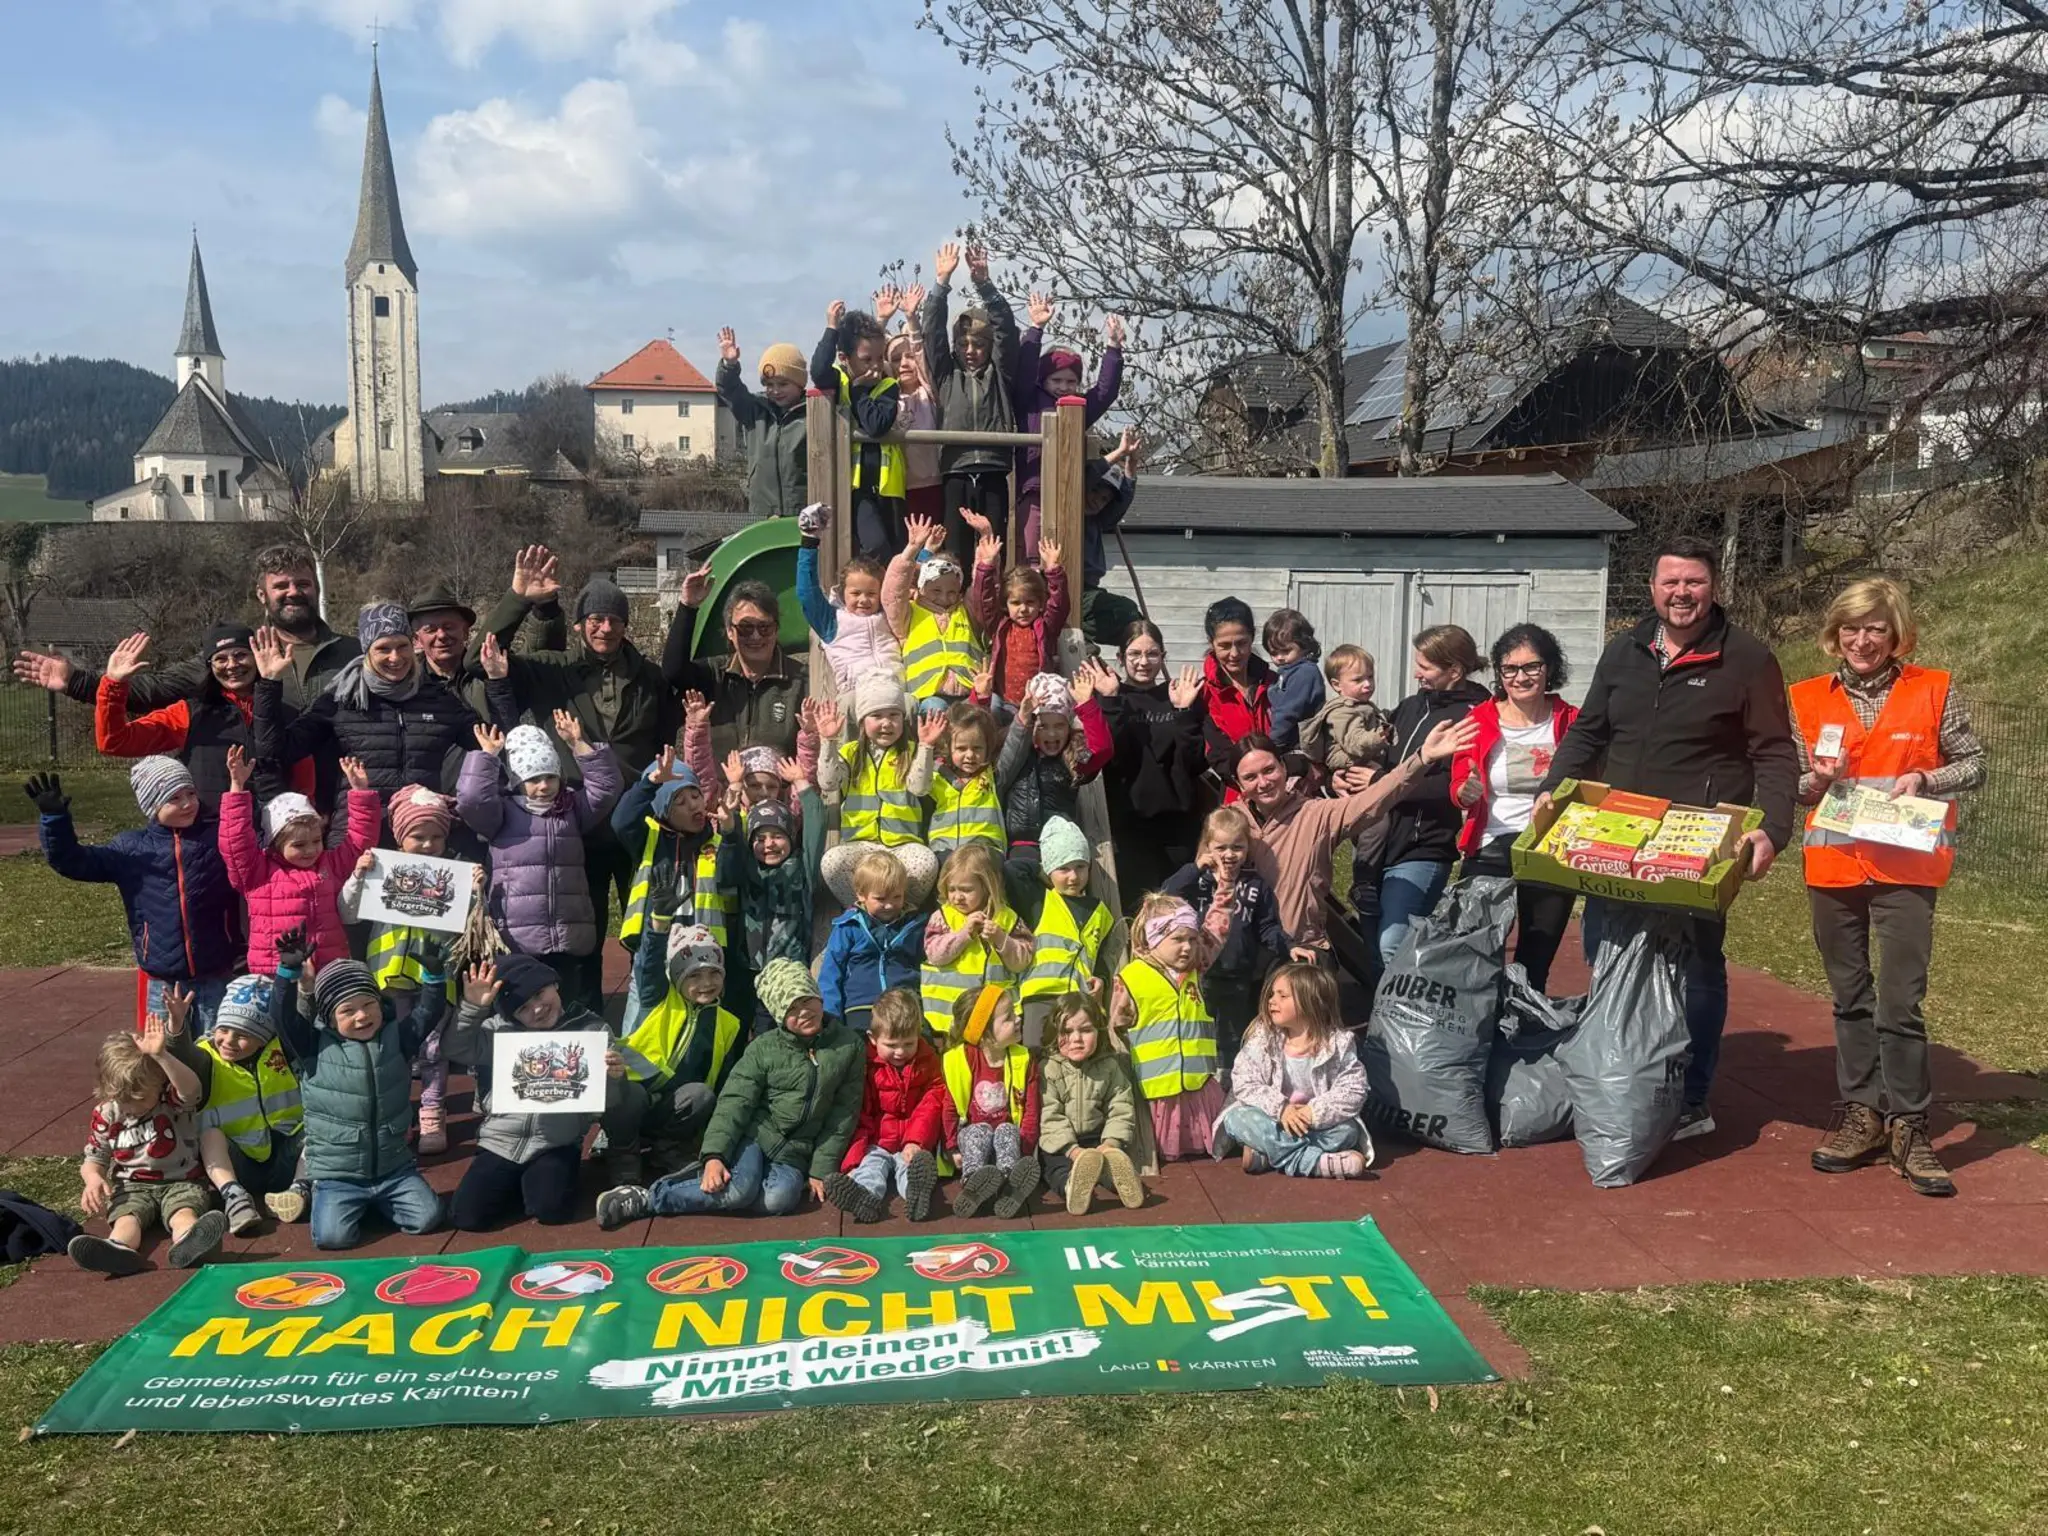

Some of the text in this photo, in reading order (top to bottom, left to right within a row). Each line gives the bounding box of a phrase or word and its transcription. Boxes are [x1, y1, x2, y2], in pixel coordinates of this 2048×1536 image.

[1570, 854, 1629, 874] Cornetto
[1578, 875, 1646, 901] Kolios
[391, 900, 439, 916] Sörgerberg
[523, 1086, 575, 1098] Sörgerberg
[1131, 1247, 1343, 1260] Landwirtschaftskammer
[1134, 1257, 1210, 1268] Kärnten
[652, 1285, 1035, 1349] NICHT
[1072, 1274, 1389, 1342] MIST!
[644, 1331, 959, 1381] Nimm deinen
[1099, 1357, 1277, 1373] LAND KÄRNTEN
[681, 1336, 1074, 1398] Mist wieder mit!
[144, 1367, 560, 1389] Gemeinsam für ein sauberes
[125, 1385, 531, 1408] und lebenswertes Kärnten!
